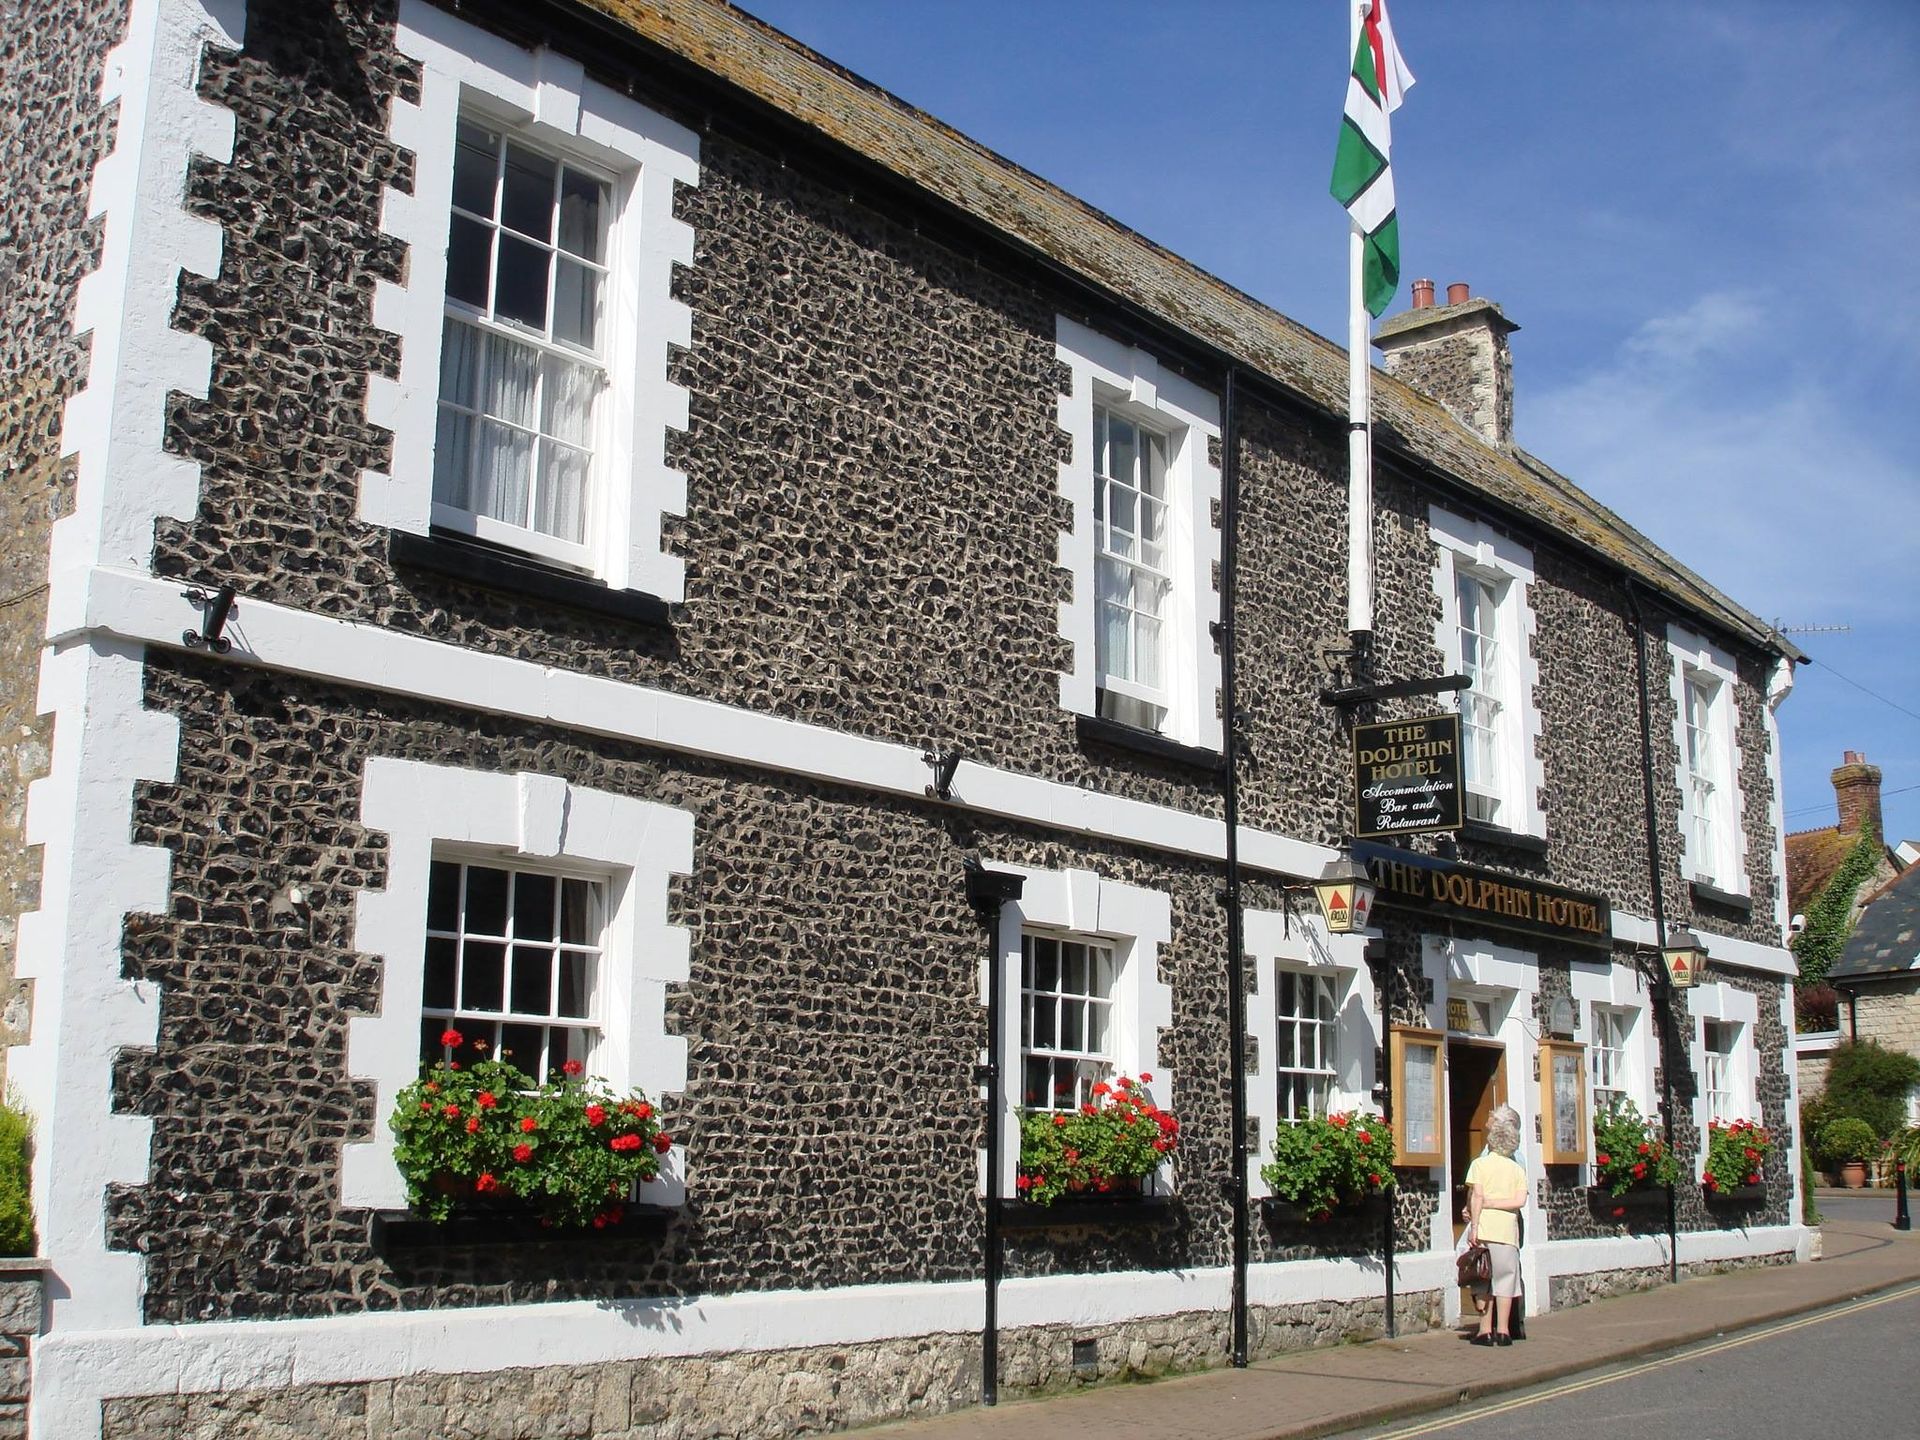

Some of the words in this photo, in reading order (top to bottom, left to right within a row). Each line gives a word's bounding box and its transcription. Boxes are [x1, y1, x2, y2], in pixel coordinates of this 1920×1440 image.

[1384, 725, 1427, 744] THE
[1360, 740, 1453, 765] DOLPHIN
[1371, 759, 1442, 781] HOTEL
[1361, 780, 1454, 799] Accommodation
[1379, 798, 1408, 814] Bar
[1412, 796, 1436, 811] and
[1375, 814, 1441, 830] Restaurant
[1373, 856, 1426, 898] THE
[1431, 869, 1533, 920] DOLPHIN
[1536, 892, 1606, 935] HOTEL
